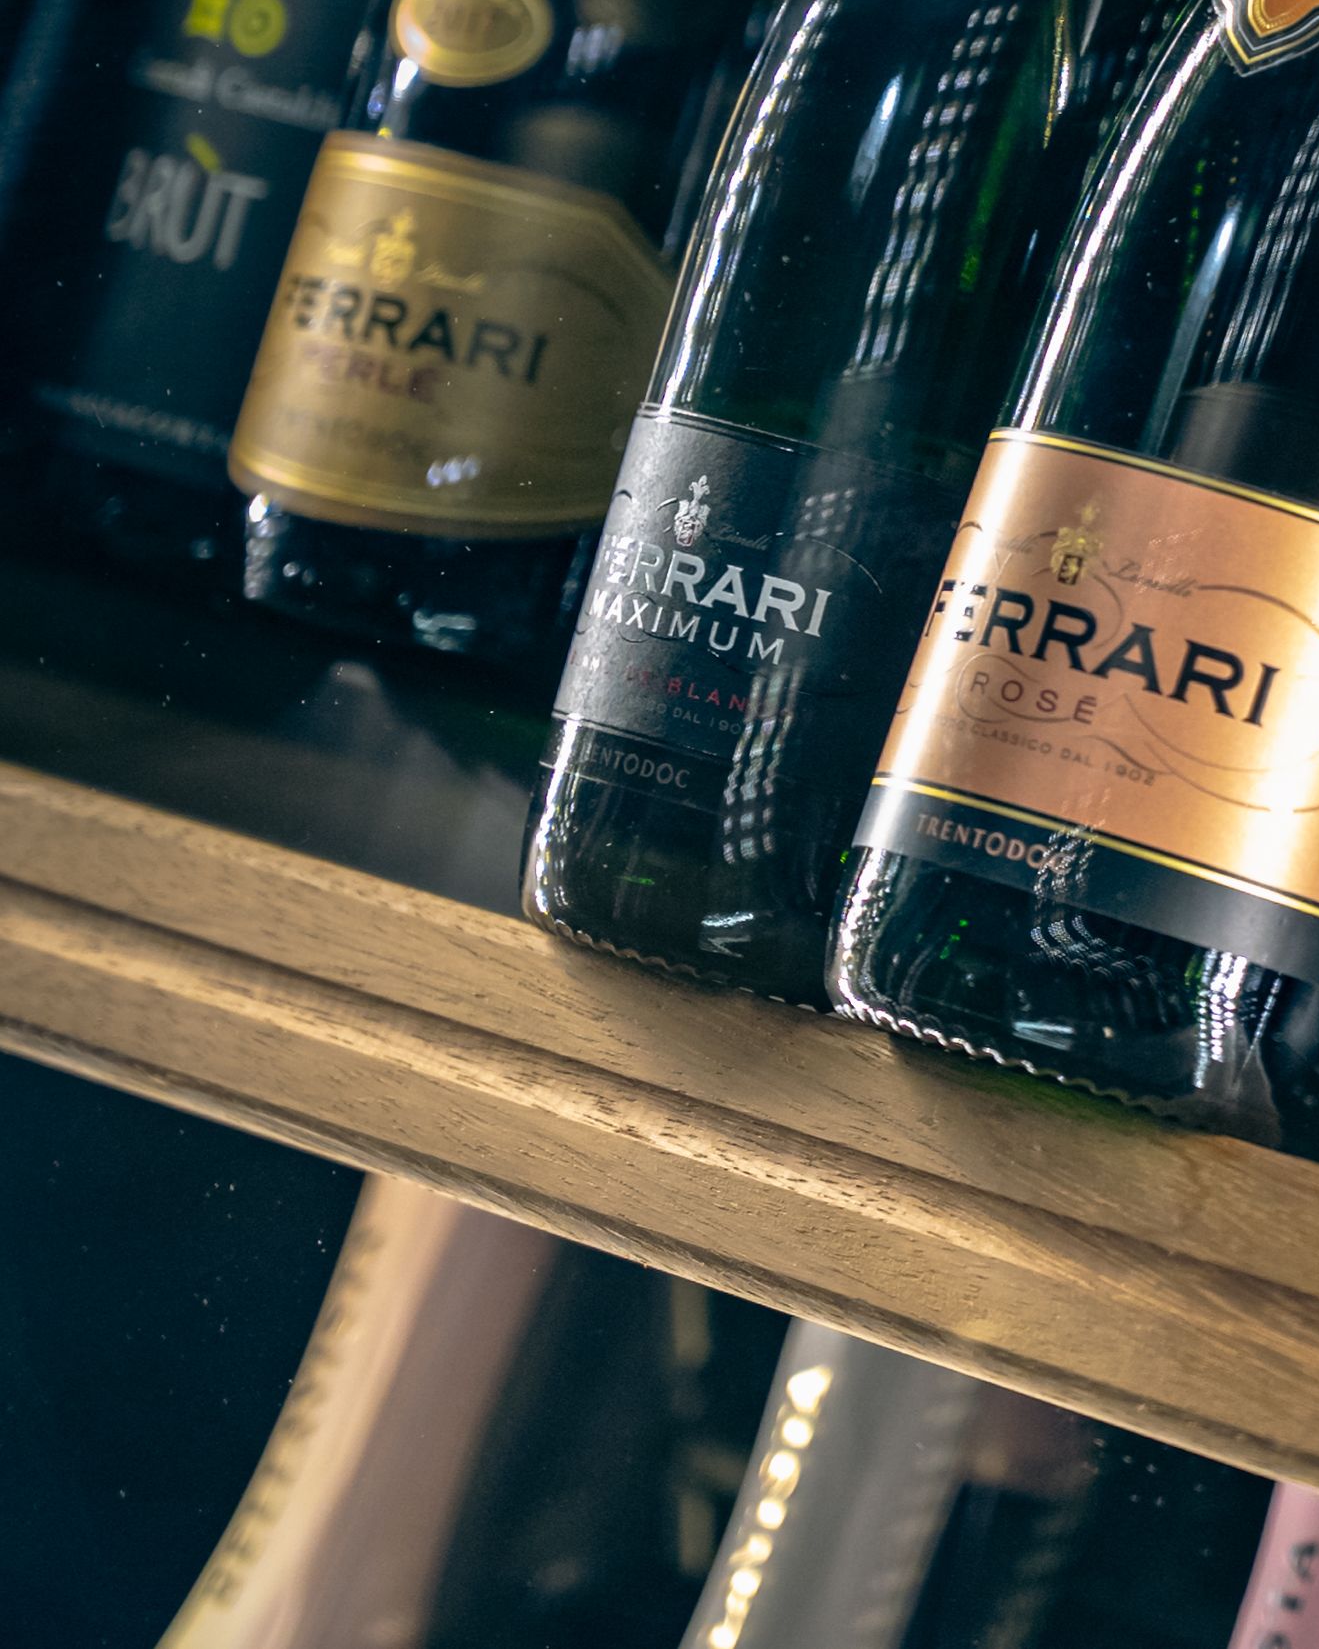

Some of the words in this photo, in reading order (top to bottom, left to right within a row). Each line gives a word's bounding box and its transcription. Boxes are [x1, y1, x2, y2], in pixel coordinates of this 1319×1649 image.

[588, 588, 785, 666] MAXIMUM
[708, 716, 744, 736] 190
[969, 670, 1097, 726] ROSÉ
